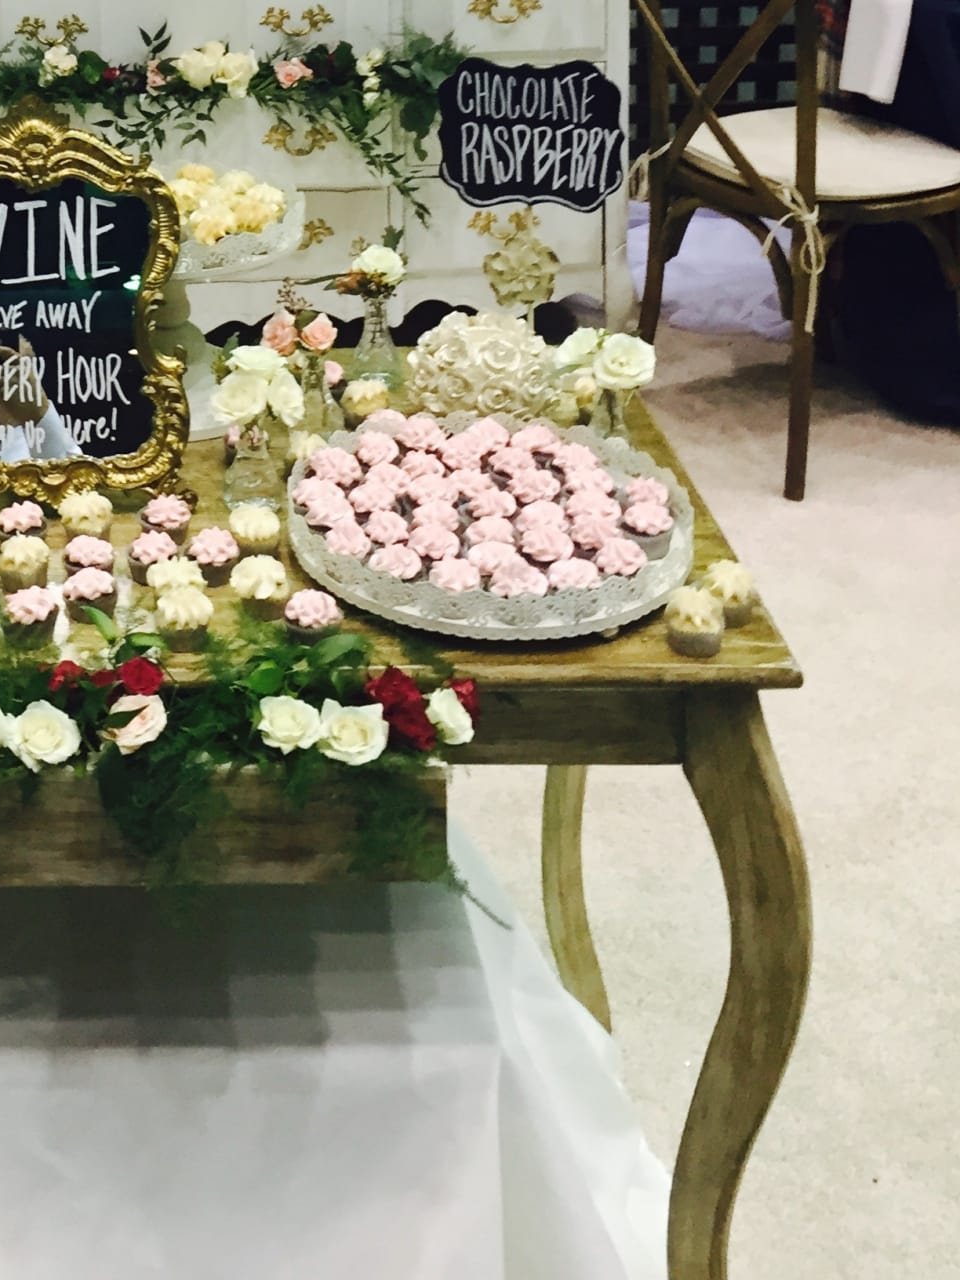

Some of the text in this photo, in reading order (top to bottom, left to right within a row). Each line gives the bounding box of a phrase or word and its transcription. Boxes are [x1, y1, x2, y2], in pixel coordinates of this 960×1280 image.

[456, 70, 599, 124] CHOCOLATE
[460, 121, 621, 194] RASPBERRY
[35, 290, 102, 334] AWAY
[56, 347, 132, 406] HOUR
[59, 406, 118, 446] Here!
